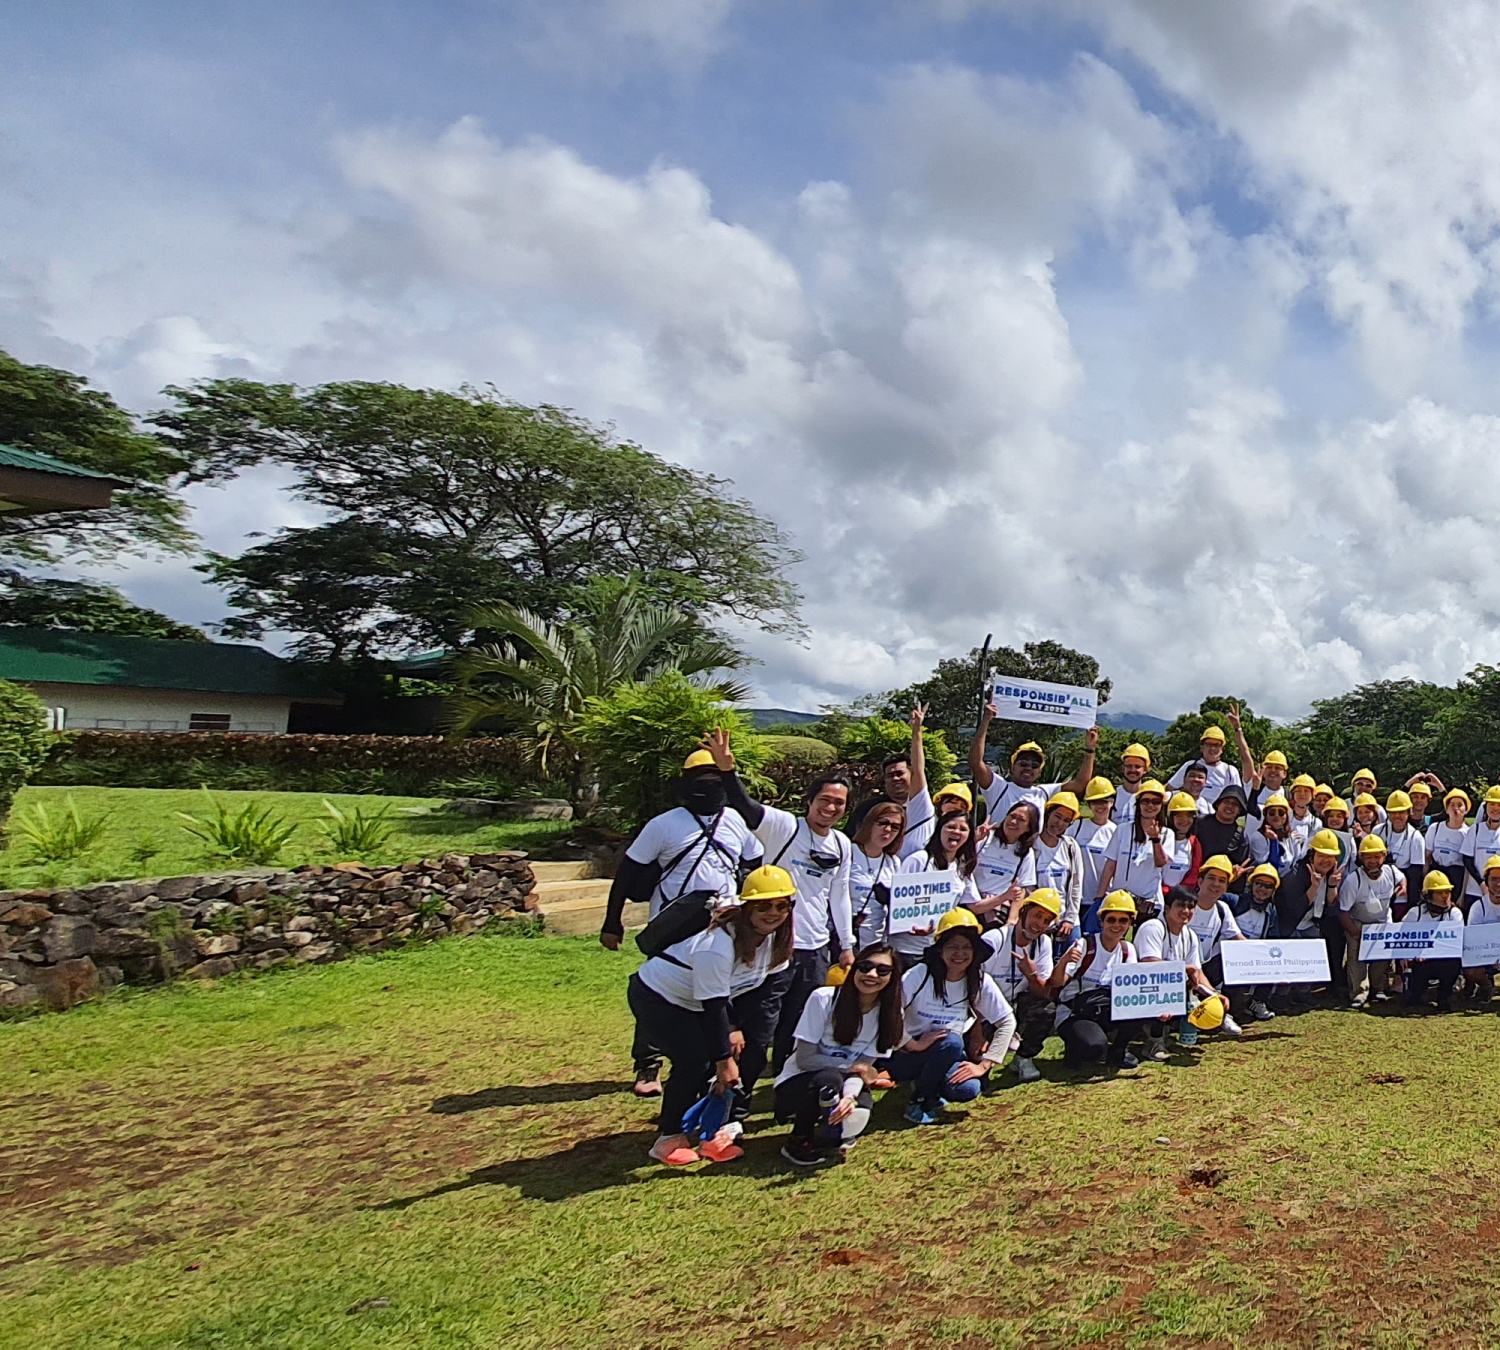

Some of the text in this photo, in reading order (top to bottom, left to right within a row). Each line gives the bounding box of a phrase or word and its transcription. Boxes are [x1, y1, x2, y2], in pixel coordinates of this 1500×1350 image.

[994, 684, 1093, 708] RESPONSIB'ALL
[1025, 701, 1043, 711] DAY
[893, 881, 951, 899] GOOD TIMES
[892, 902, 951, 920] GOOD PLACE
[1362, 929, 1458, 942] RESPONSIB'ALL
[1283, 958, 1327, 966] Philippines
[1114, 973, 1148, 987] GOOD
[1148, 971, 1184, 985] TIMES
[1113, 991, 1184, 1008] GOOD PLACE
